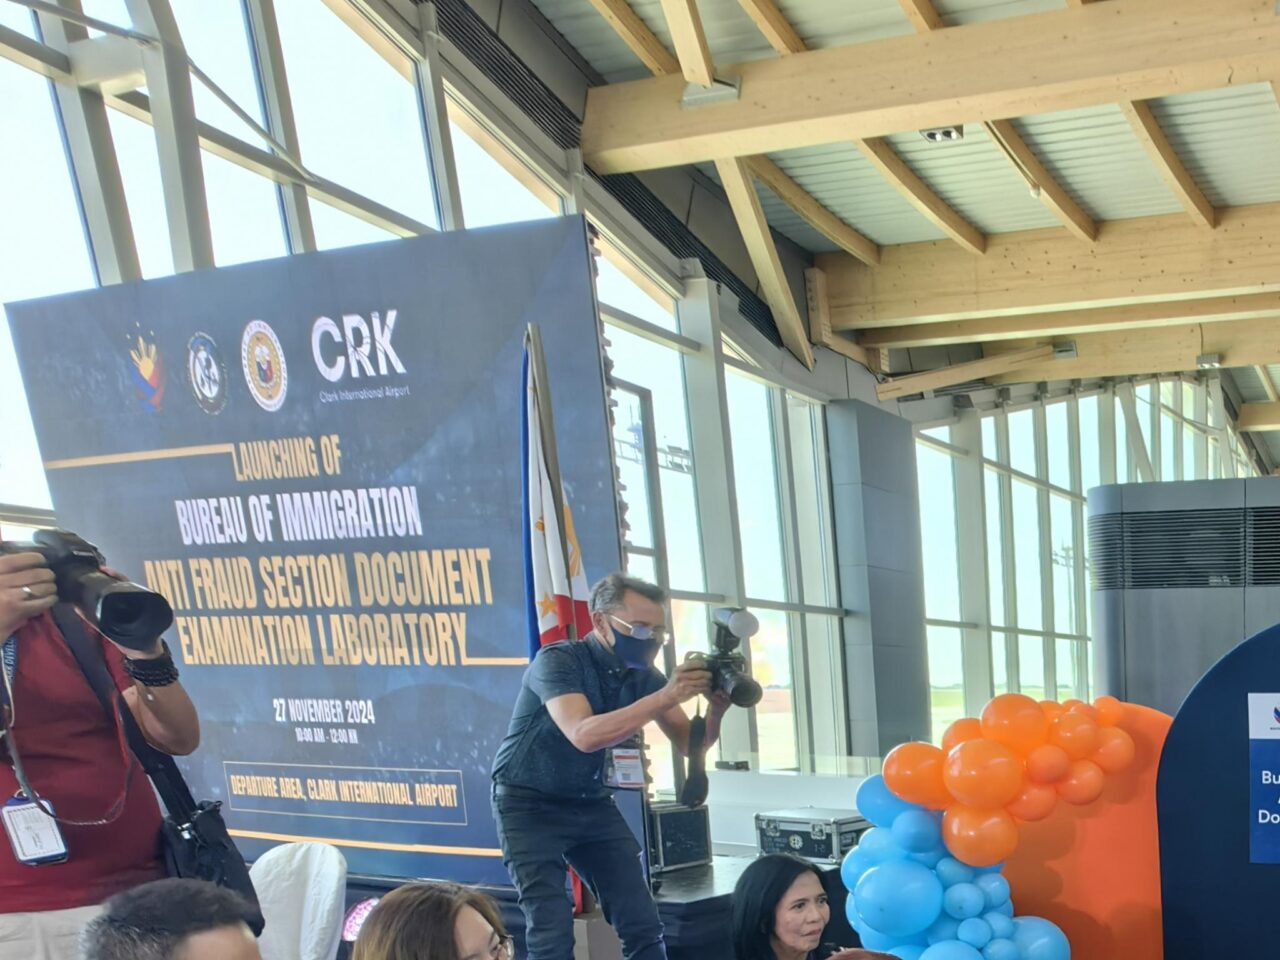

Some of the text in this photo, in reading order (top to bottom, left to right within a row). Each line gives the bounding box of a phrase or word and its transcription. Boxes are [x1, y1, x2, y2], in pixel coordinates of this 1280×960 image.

[311, 309, 407, 383] CRK
[232, 434, 342, 481] LAUNCHING OF
[175, 486, 423, 545] BUREAU OF IMMIGRATION
[144, 548, 493, 610] ANTI FRAUD SECTION DOCUMENT
[176, 612, 469, 666] EXAMINATION LABORATORY
[273, 698, 375, 724] 27 NOVEMBER 2024
[295, 727, 313, 743] 10:00
[313, 728, 326, 743] AM
[330, 728, 348, 744] 12:00
[348, 729, 359, 744] NN
[231, 775, 458, 807] DEPARTURE AREA, CLARK INTERNATIONAL AIRPORT
